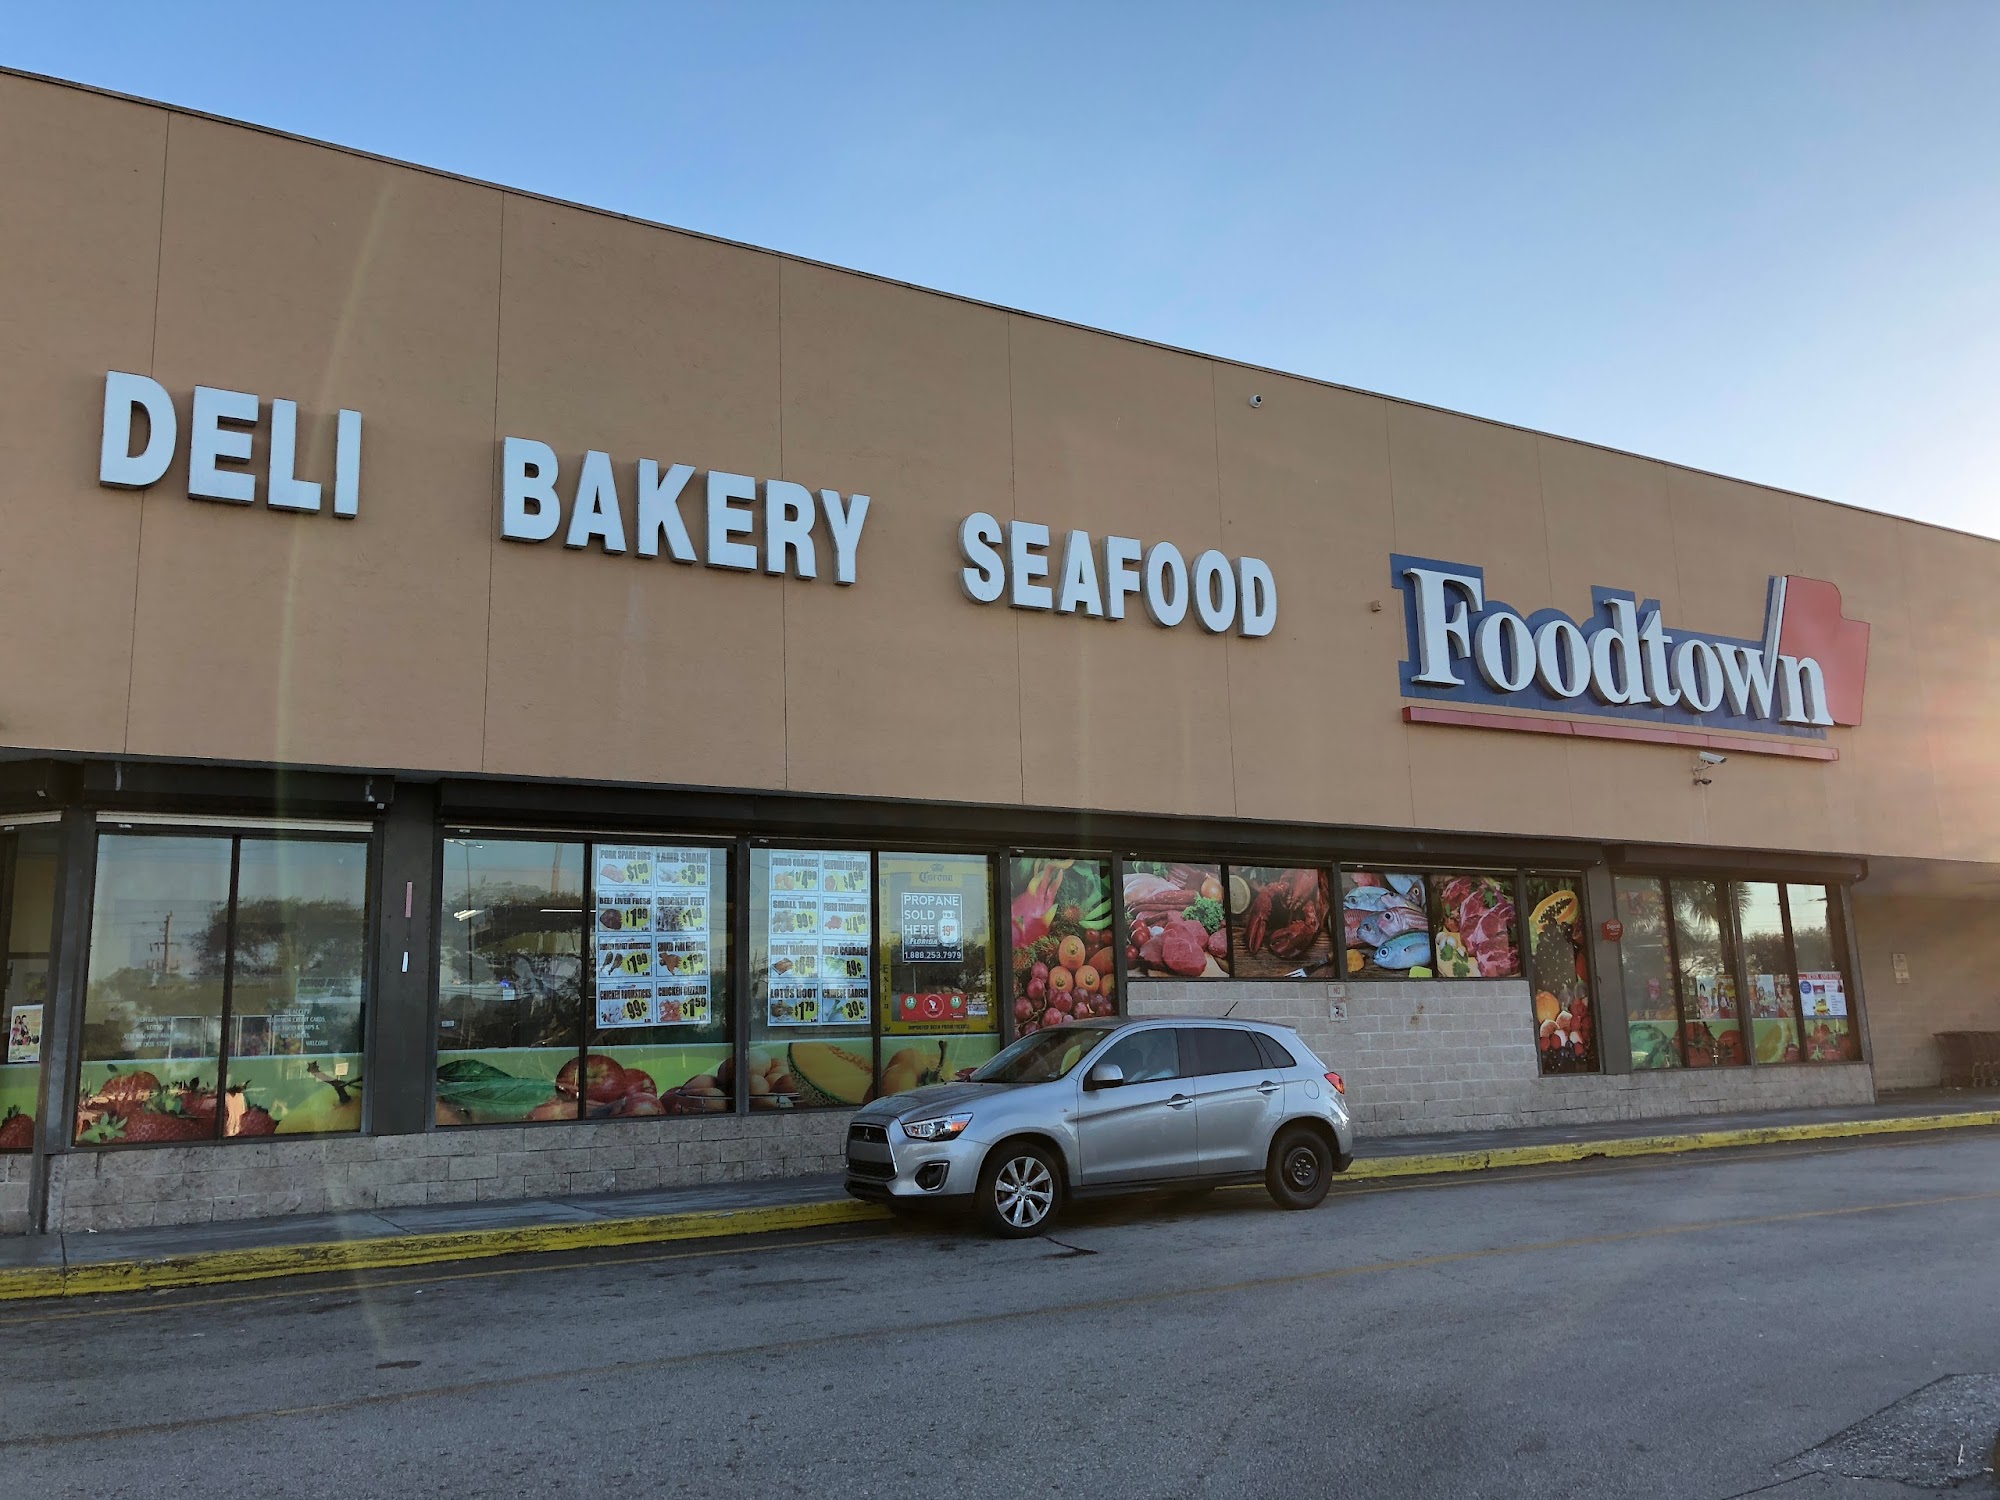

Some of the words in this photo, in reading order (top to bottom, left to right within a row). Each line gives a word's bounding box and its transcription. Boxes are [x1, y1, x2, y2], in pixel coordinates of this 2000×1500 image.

[100, 370, 362, 519] DELI
[501, 437, 870, 585] BAKERY
[958, 512, 1277, 638] SEAFOOD
[1403, 567, 1834, 727] Foodtown
[600, 850, 617, 860] PORK
[618, 850, 636, 860] SPARE
[657, 853, 679, 863] LAMB
[772, 858, 792, 867] JUMBO
[919, 871, 953, 883] Corona
[600, 897, 614, 905] BEEF
[615, 897, 632, 905] LIVER
[632, 897, 651, 905] FRESH
[657, 897, 689, 906] CHICKEN
[690, 897, 706, 906] FEET
[773, 900, 796, 908] SMALL
[904, 895, 959, 906] PROPANE
[904, 910, 935, 920] SOLD
[904, 925, 935, 935] HERE
[909, 937, 938, 945] FLORIDA
[904, 951, 961, 959] 1.888.253.7979
[658, 987, 682, 996] CHICKEN
[683, 986, 706, 996] GIZZARD
[771, 988, 794, 998] LOTUS
